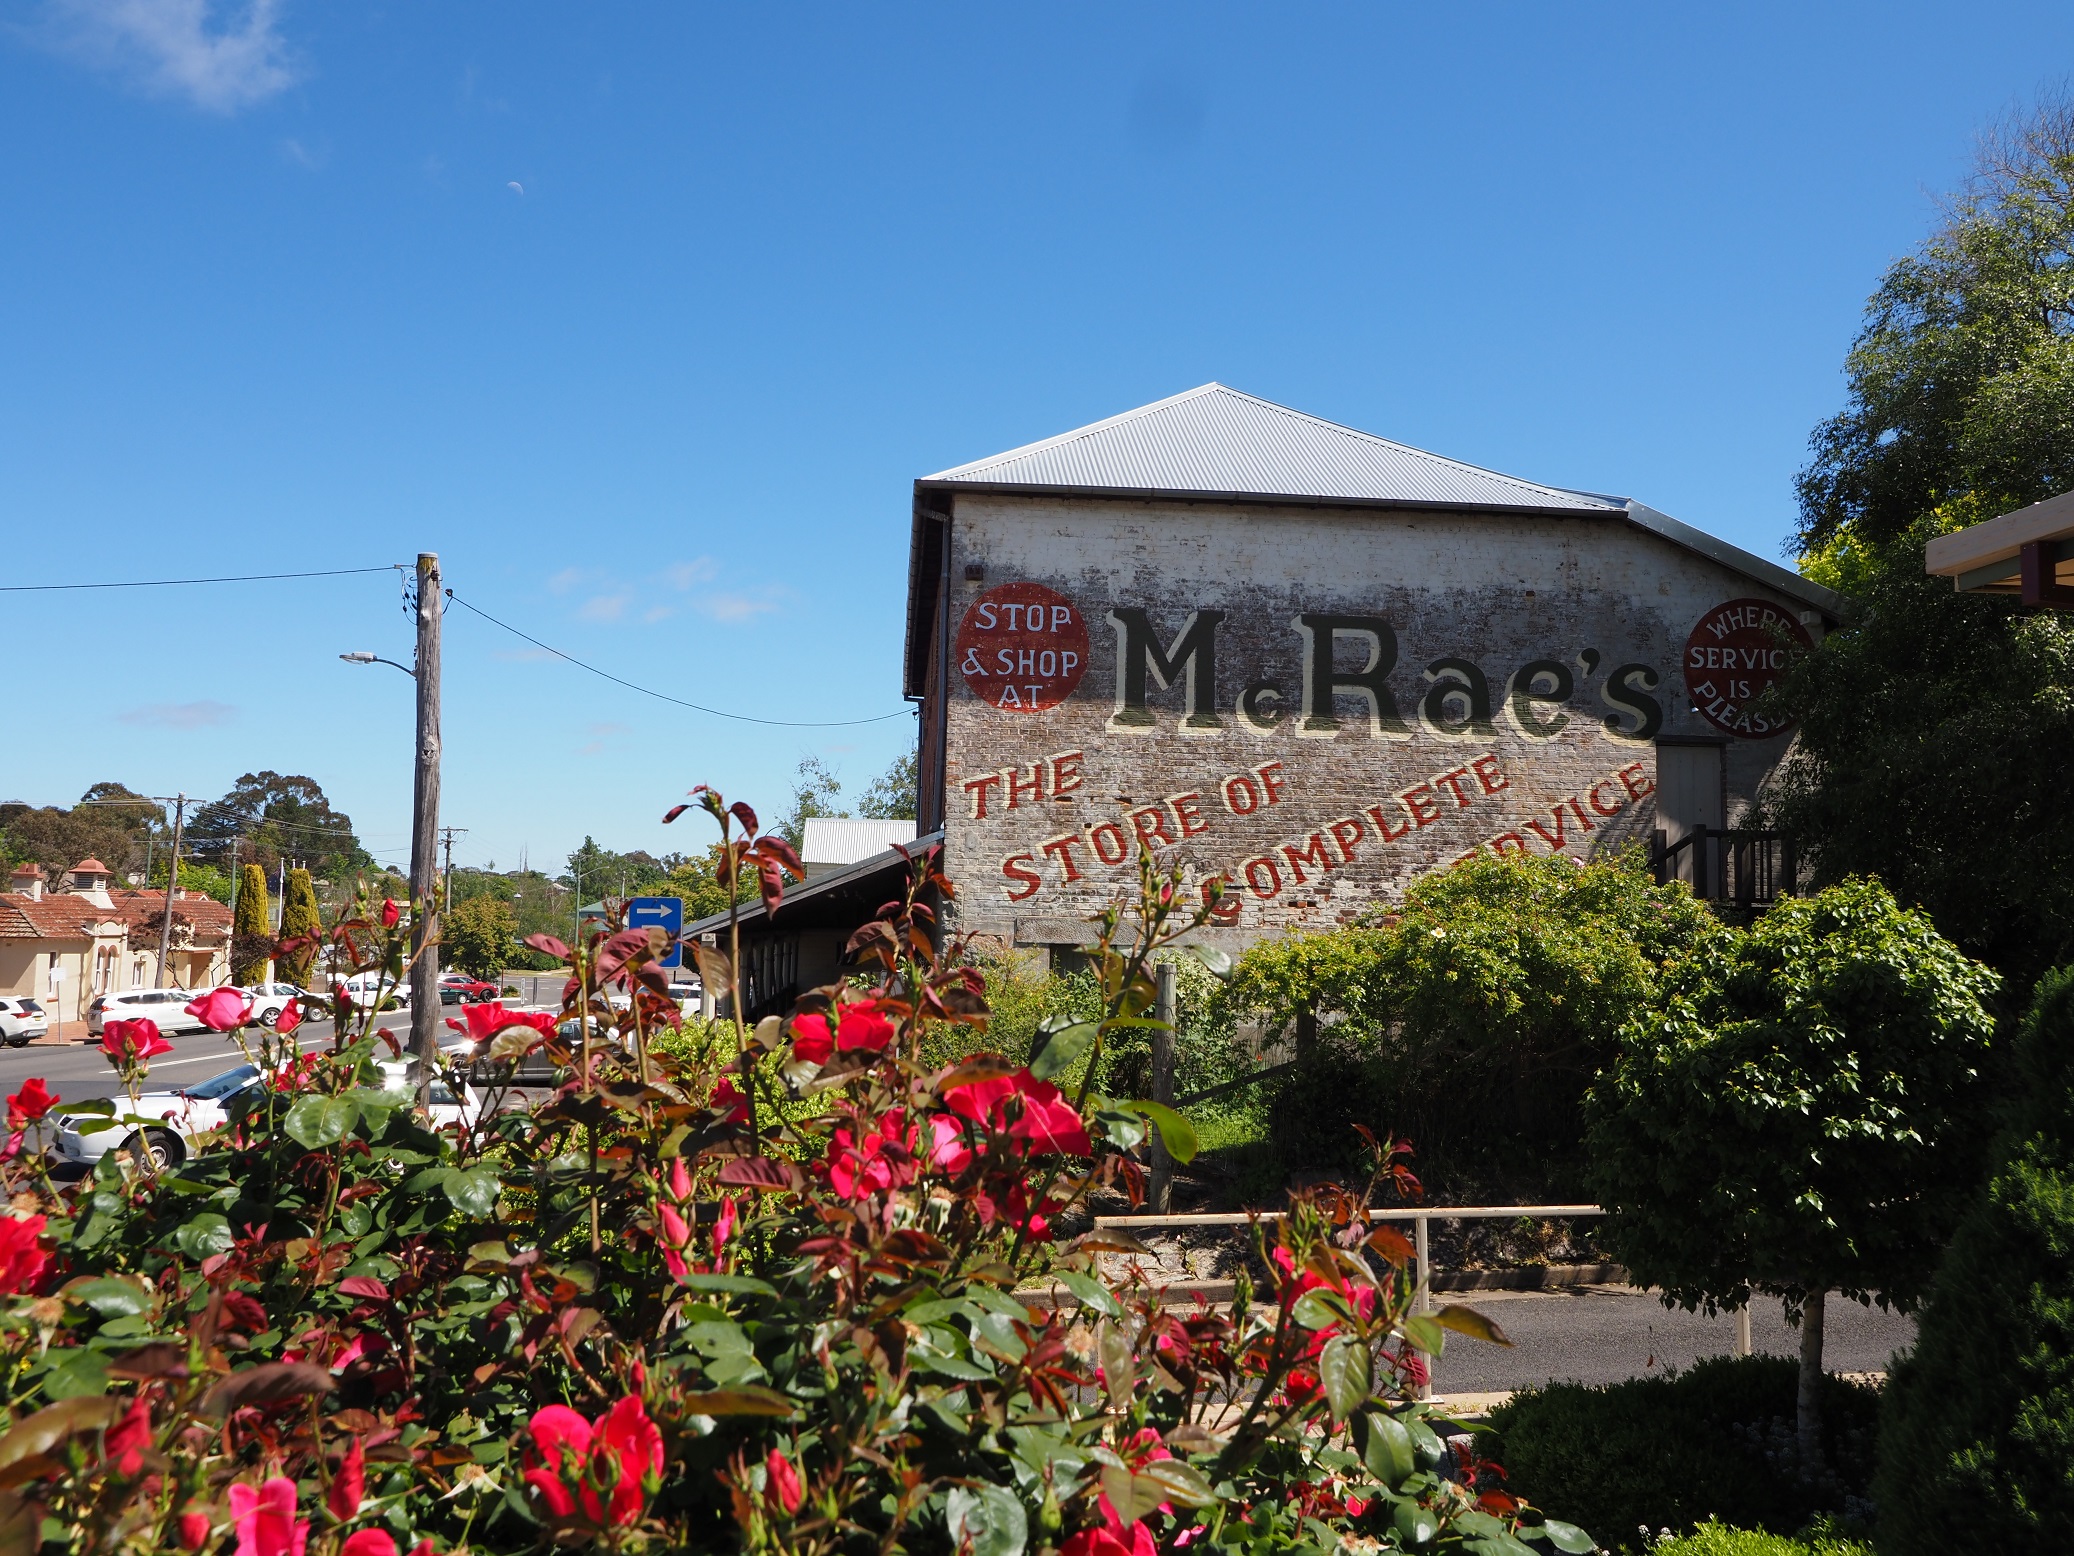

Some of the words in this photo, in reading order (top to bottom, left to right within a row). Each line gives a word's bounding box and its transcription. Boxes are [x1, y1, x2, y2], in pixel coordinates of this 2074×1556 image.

[974, 602, 1072, 633] STOP
[961, 646, 989, 676] &
[996, 648, 1079, 677] SHOP
[997, 684, 1044, 709] AT
[1729, 679, 1751, 699] IS
[960, 749, 1084, 820] THE
[1000, 792, 1209, 902] STORE
[1220, 760, 1286, 816] OF
[1200, 752, 1511, 920] COMPLETE
